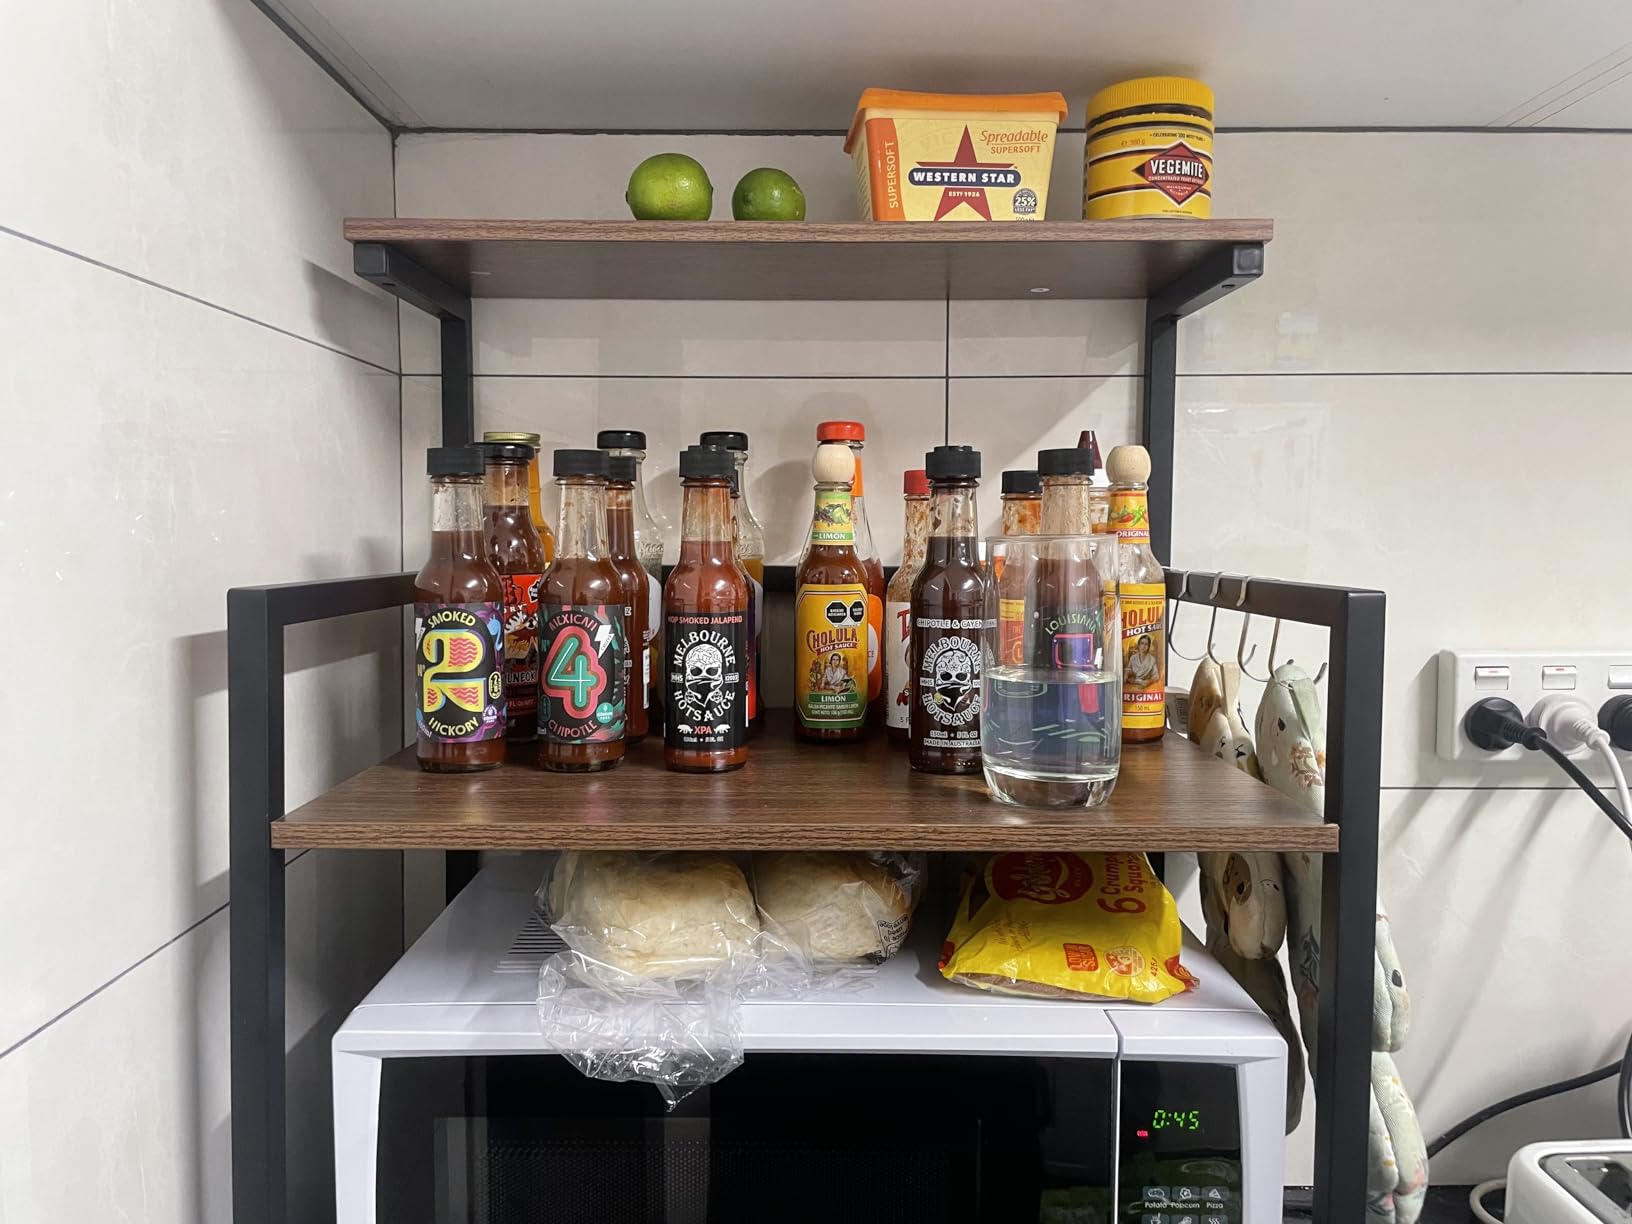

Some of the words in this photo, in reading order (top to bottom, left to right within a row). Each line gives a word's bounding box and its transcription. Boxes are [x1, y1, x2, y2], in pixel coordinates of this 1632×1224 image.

[980, 130, 1048, 145] Spreadable
[990, 145, 1041, 154] SUPERSOFT
[884, 141, 898, 208] SUPERSOFT
[1150, 159, 1203, 178] VEGEMITE
[913, 172, 976, 183] WESTERN
[981, 173, 1016, 184] STAR
[1014, 196, 1036, 207] 25%
[428, 610, 476, 628] SMOKED
[548, 613, 598, 632] MEXICAN
[679, 616, 709, 625] SMOKED
[917, 618, 950, 628] CHIPOTLE
[952, 620, 960, 629] &
[1045, 613, 1096, 635] LOUISIANA
[806, 628, 858, 653] CHOLULA
[1126, 626, 1146, 637] HOT
[673, 630, 736, 667] MELBOURNE
[820, 645, 833, 653] HOT
[422, 629, 487, 713] 2
[545, 631, 603, 714] 4
[1124, 692, 1162, 702] RIGINAL
[428, 716, 479, 736] HICKORY
[548, 720, 598, 738] CHIPOTLE
[694, 726, 713, 734] XPA
[1100, 852, 1124, 894] Crump
[1096, 898, 1146, 913] 6
[1153, 1109, 1199, 1129] 0:45
